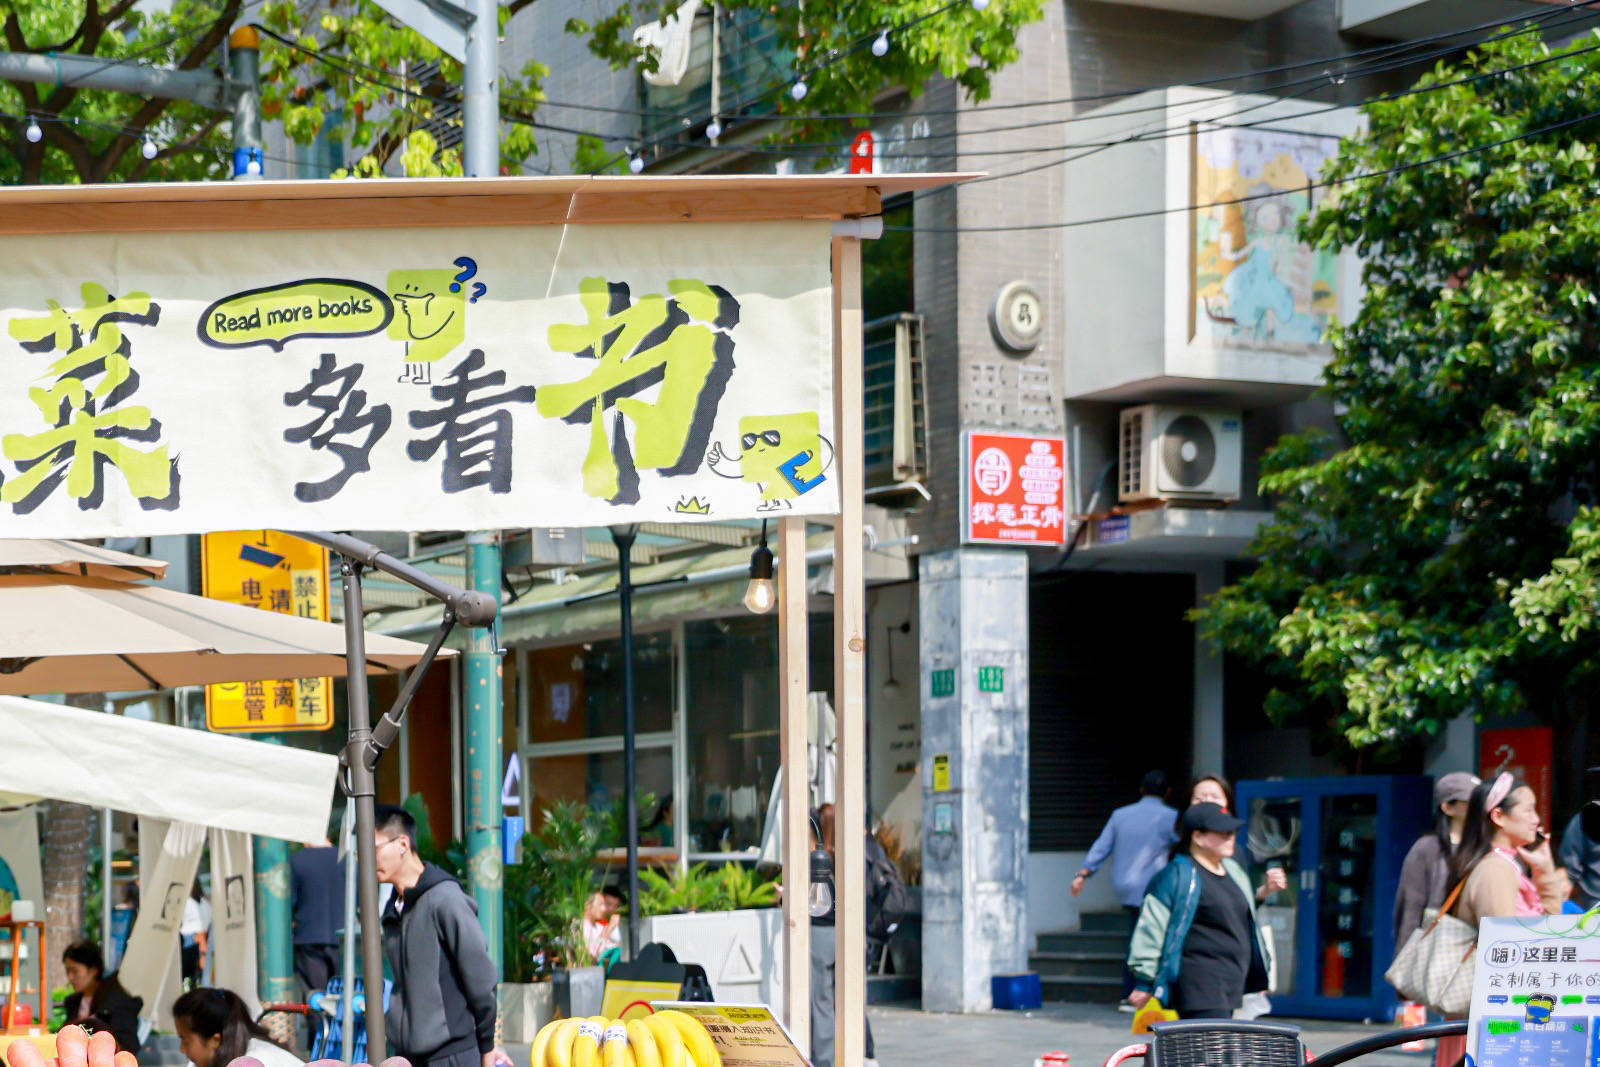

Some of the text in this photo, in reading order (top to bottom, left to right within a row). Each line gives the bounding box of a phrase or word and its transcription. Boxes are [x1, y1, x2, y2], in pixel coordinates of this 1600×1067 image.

[214, 296, 373, 334] Read more books
[283, 276, 741, 505] 多看书
